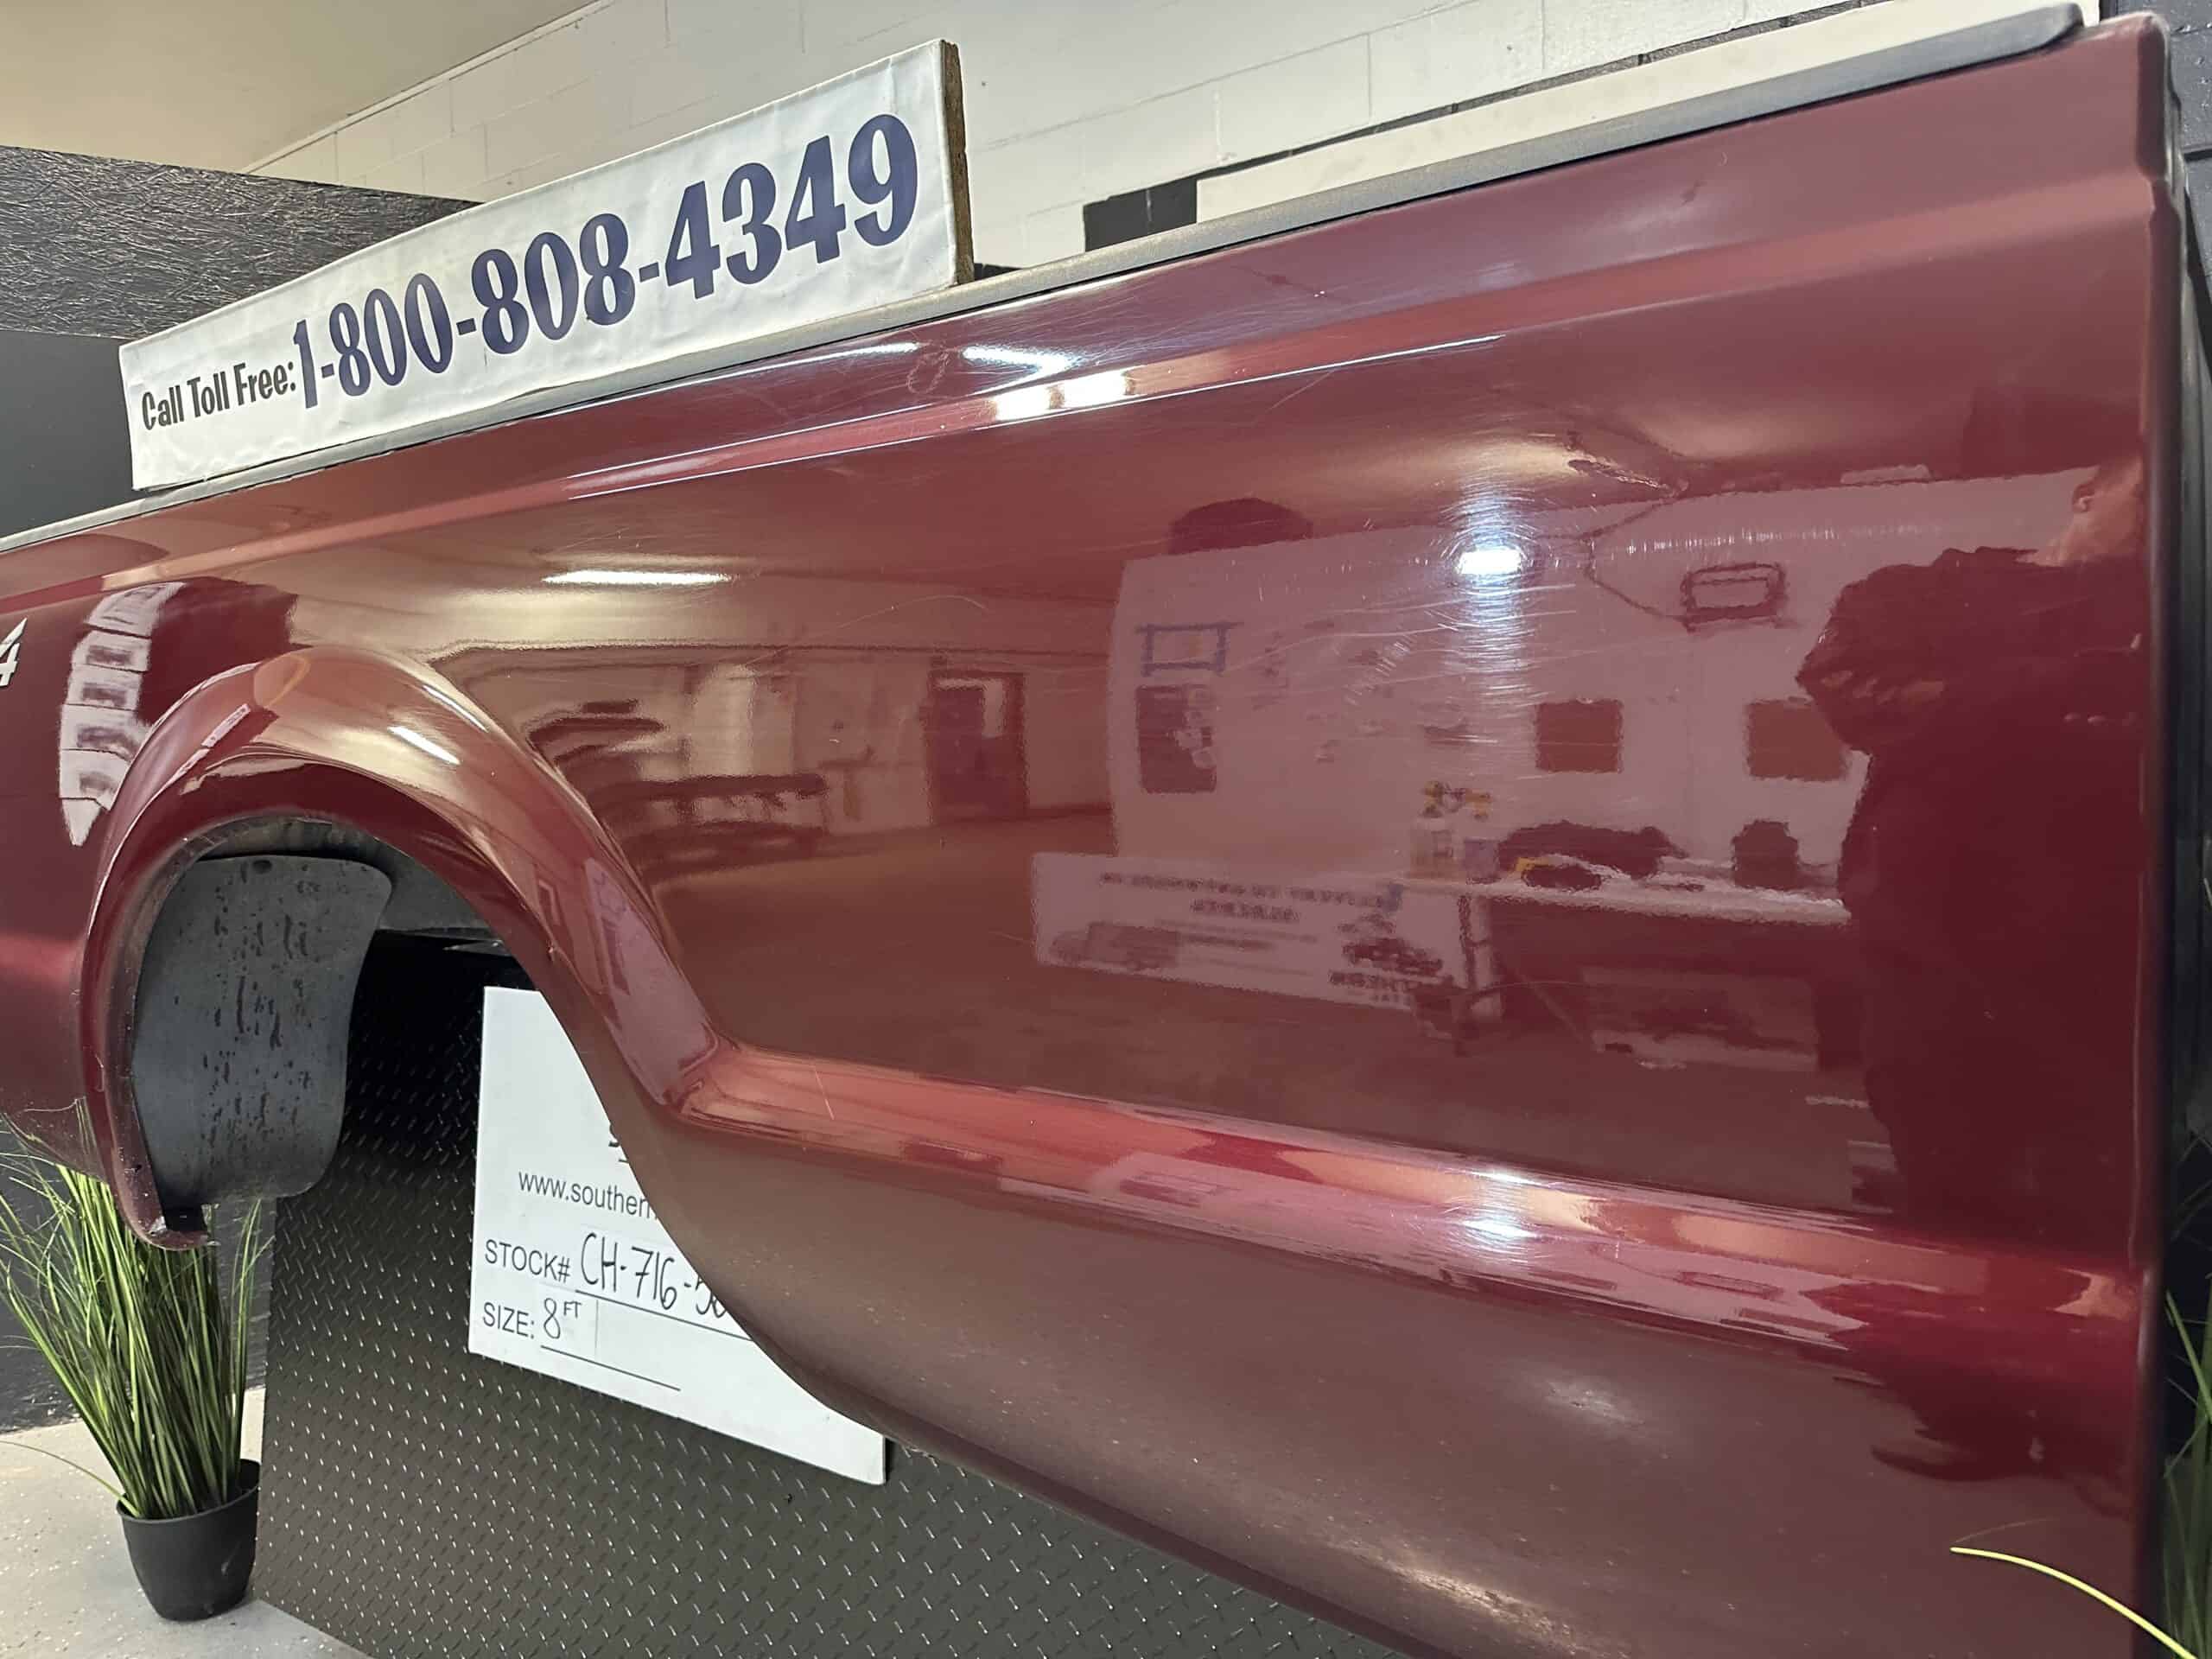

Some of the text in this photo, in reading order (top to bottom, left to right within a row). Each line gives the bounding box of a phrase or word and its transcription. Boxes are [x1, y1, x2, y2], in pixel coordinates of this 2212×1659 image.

[141, 113, 918, 431] Call Toll Free: 1-800-808-4349
[485, 1238, 571, 1283] STOCK#
[482, 1301, 535, 1339] SIZE:
